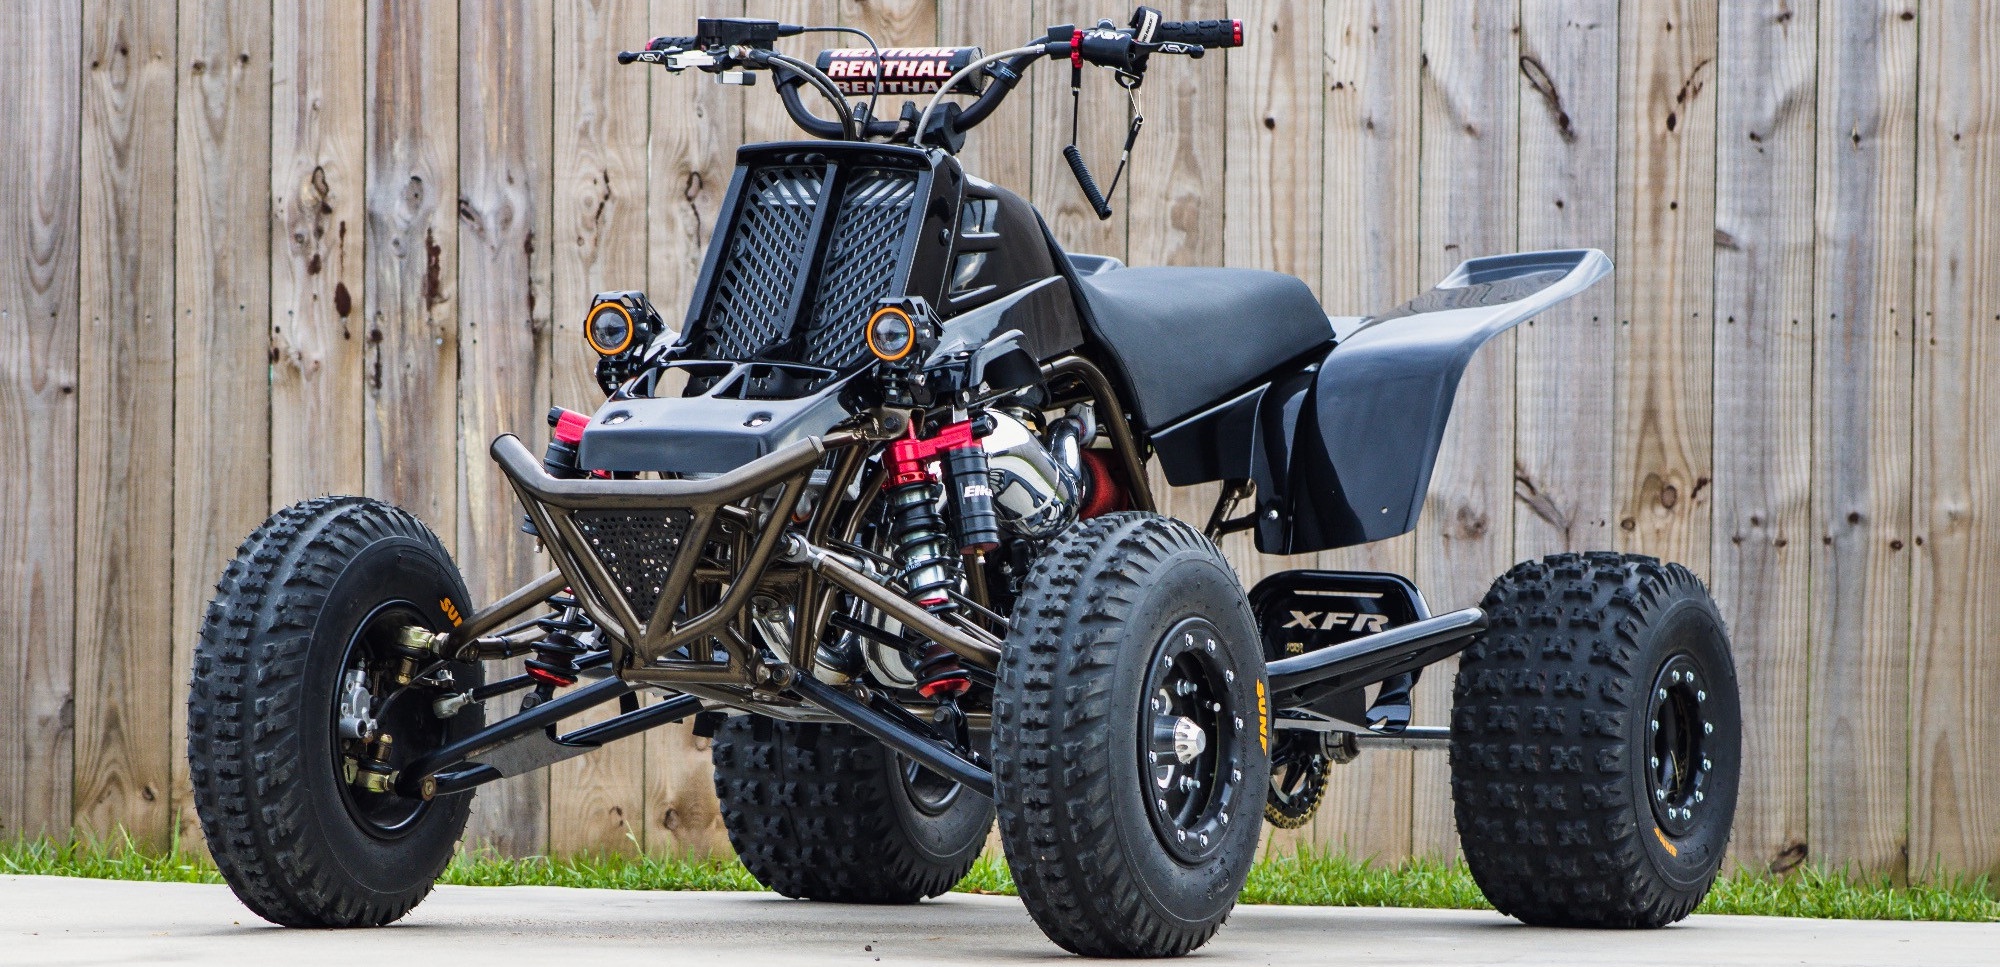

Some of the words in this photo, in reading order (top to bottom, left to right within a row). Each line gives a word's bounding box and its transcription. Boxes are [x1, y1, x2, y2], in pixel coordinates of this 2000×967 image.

[1093, 30, 1125, 41] ASV
[1158, 43, 1188, 53] ASV
[637, 53, 661, 62] ASV
[828, 60, 952, 77] RENTHAL
[1282, 610, 1389, 633] XFR
